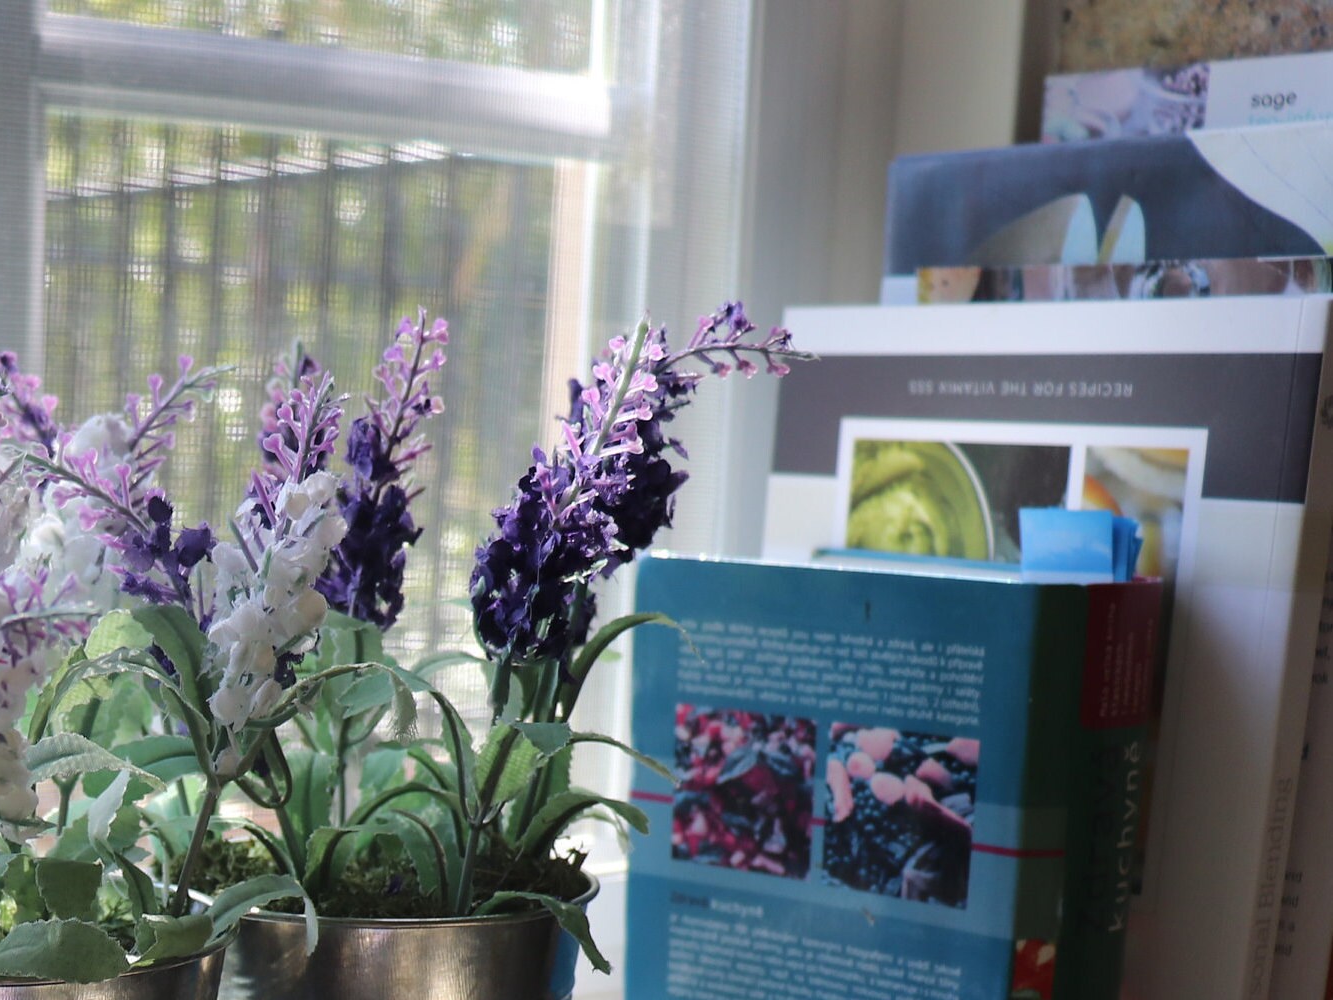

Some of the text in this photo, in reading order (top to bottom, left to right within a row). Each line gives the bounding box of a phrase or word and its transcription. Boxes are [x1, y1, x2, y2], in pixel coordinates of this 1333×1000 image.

[1251, 91, 1297, 111] sage
[937, 380, 995, 396] VITAMIX
[1000, 380, 1028, 397] THE
[1033, 381, 1064, 397] FOR
[1069, 381, 1133, 398] RECIPES
[1107, 740, 1142, 933] kuchyně
[1257, 777, 1294, 909] Blending
